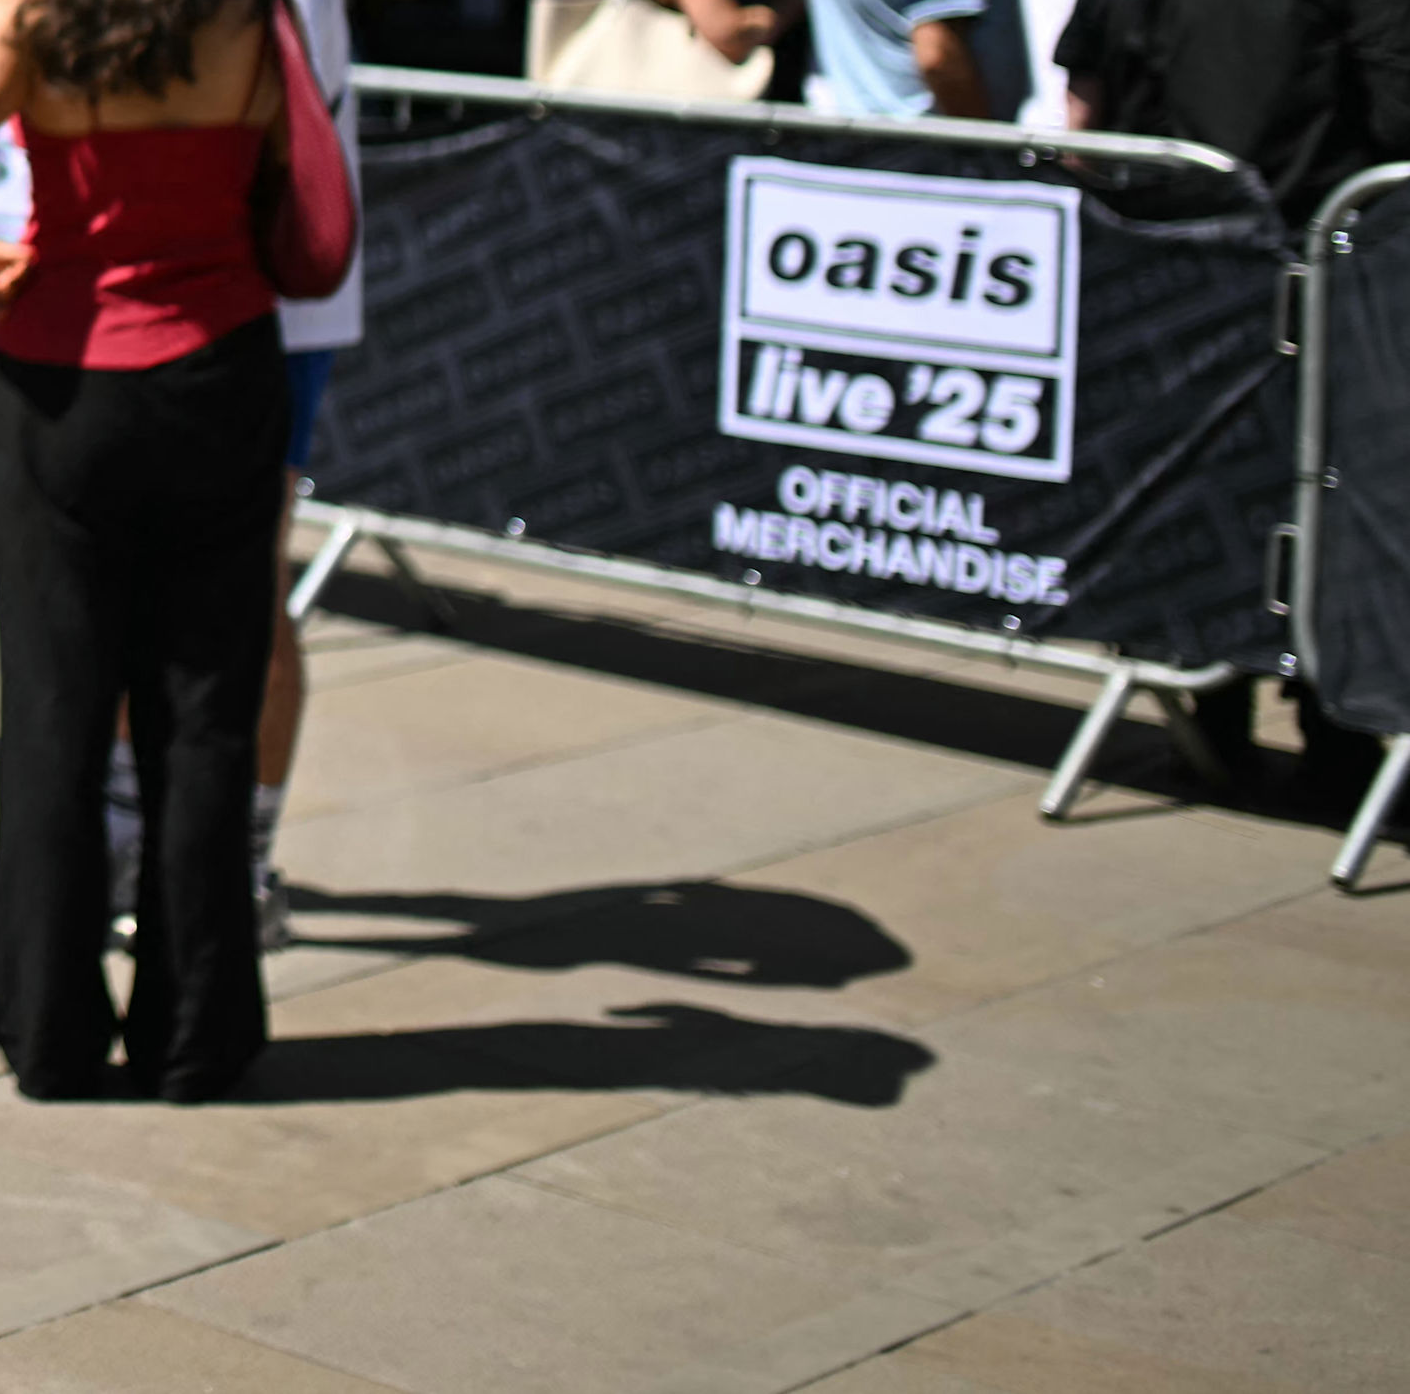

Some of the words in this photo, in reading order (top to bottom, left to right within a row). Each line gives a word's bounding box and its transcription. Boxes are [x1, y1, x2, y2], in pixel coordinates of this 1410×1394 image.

[767, 226, 1037, 308] oasis
[746, 344, 896, 435] live
[904, 363, 1045, 456] '25
[777, 464, 1000, 546] OFFICIAL
[712, 500, 1070, 607] MERCHANDISE
